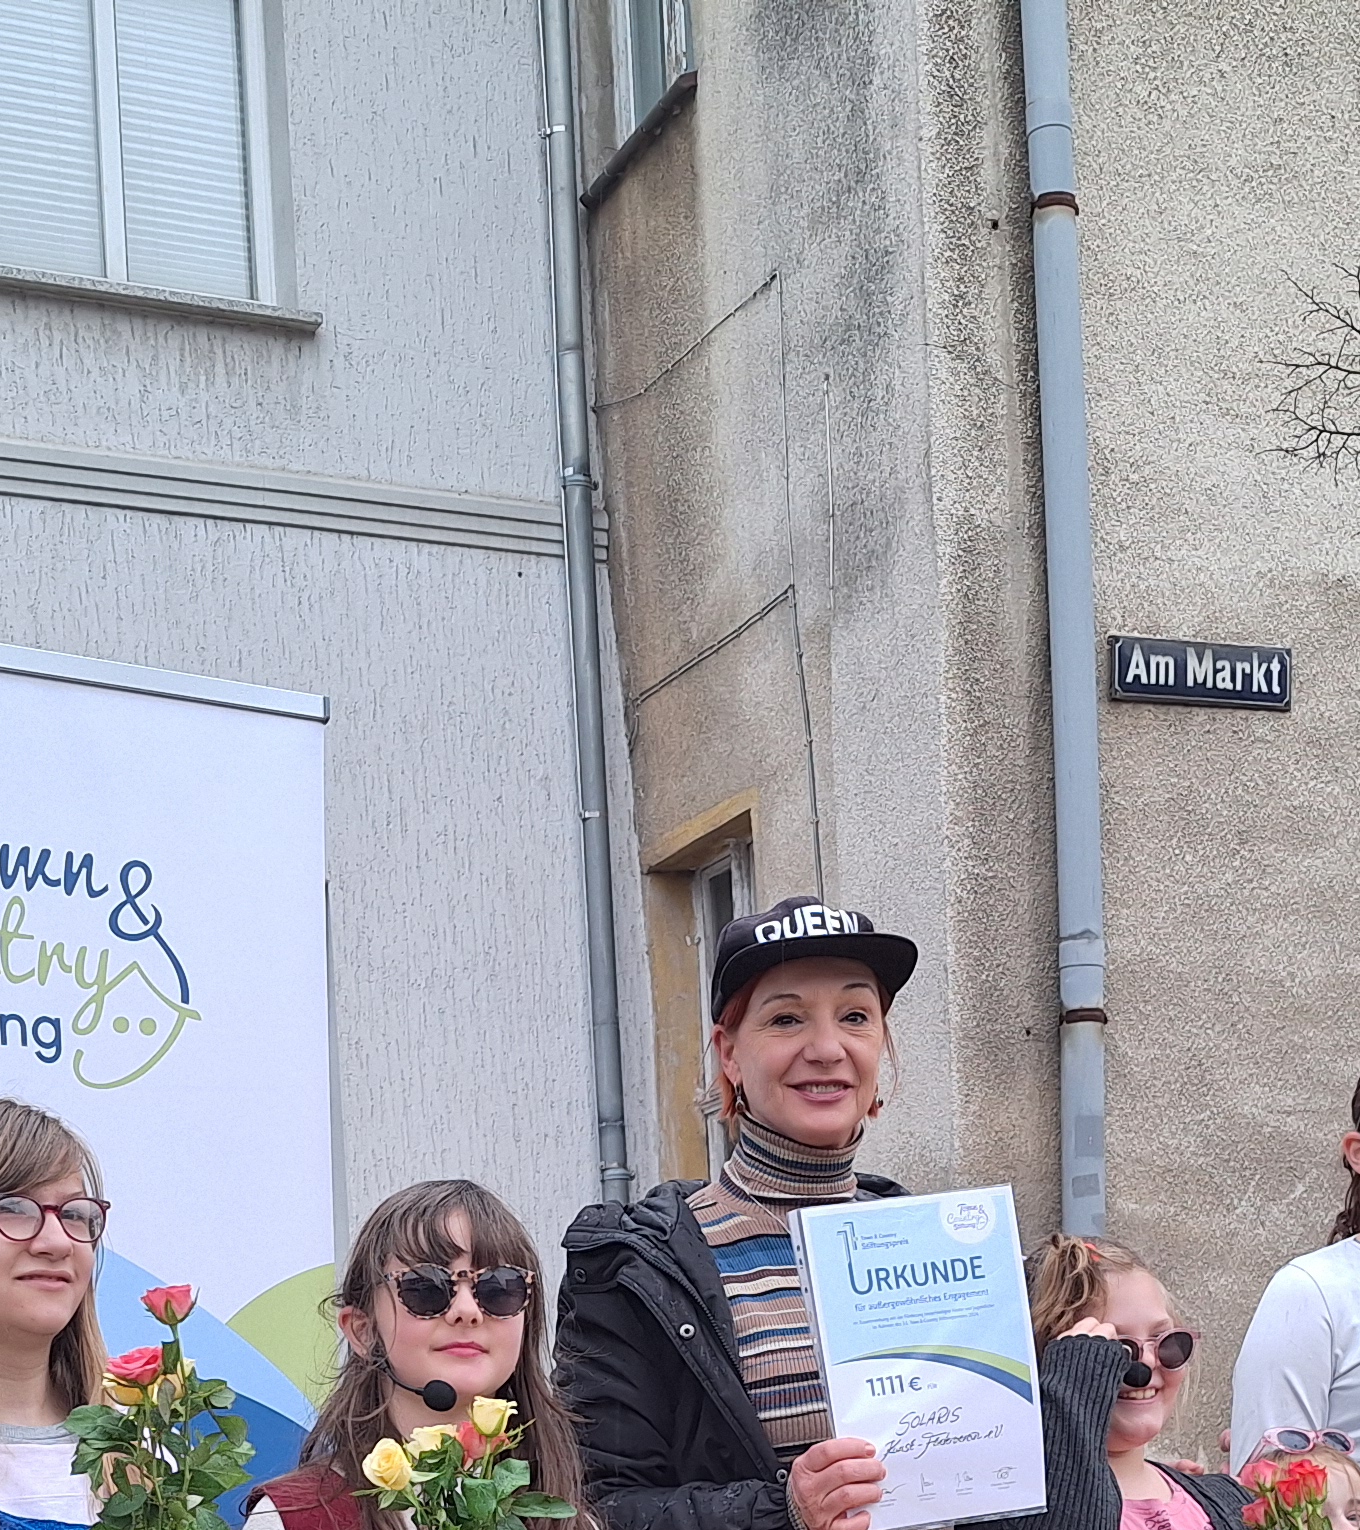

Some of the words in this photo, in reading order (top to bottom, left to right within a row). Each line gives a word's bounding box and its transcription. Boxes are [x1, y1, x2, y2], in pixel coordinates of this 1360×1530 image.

[1125, 643, 1175, 686] Am
[1186, 647, 1281, 694] Markt
[754, 904, 860, 945] QUEEN
[847, 1255, 986, 1295] URKUNDE
[895, 1406, 963, 1437] SOLARIS
